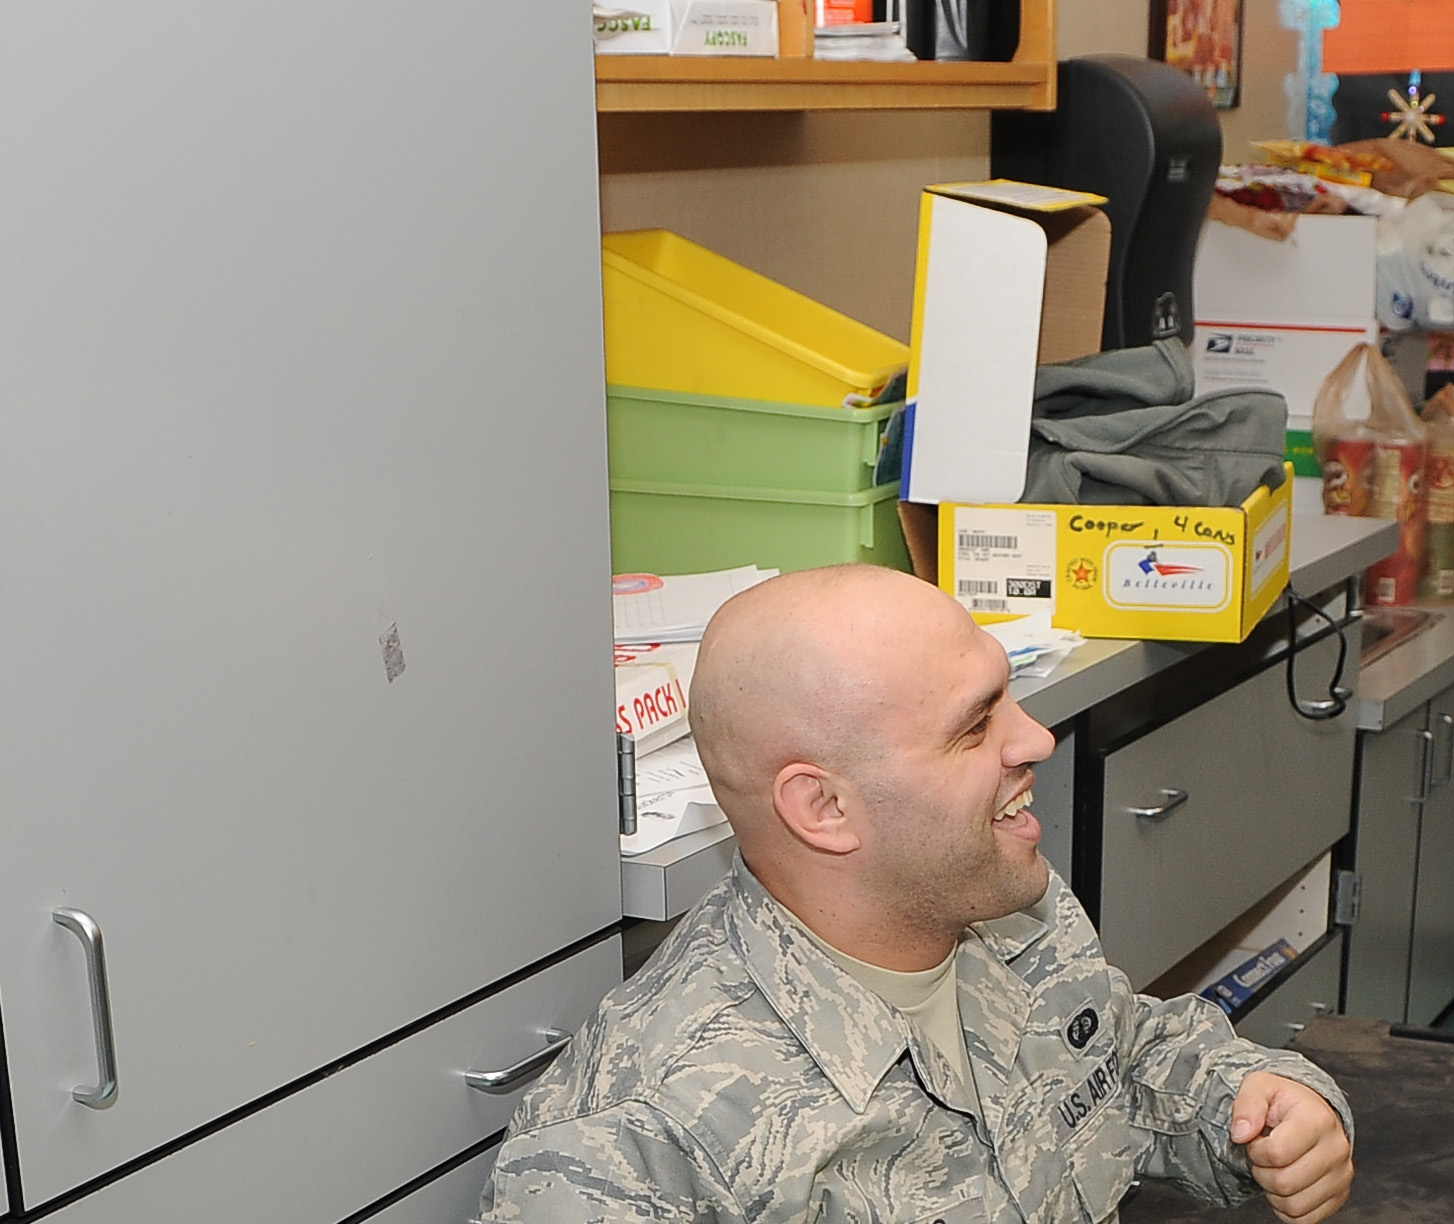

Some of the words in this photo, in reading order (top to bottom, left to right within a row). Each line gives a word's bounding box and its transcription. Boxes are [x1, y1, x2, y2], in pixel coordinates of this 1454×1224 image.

[1122, 578, 1214, 590] Belleville
[633, 682, 678, 730] PACK
[1057, 1092, 1092, 1129] U.S.
[1086, 1066, 1112, 1107] AIR
